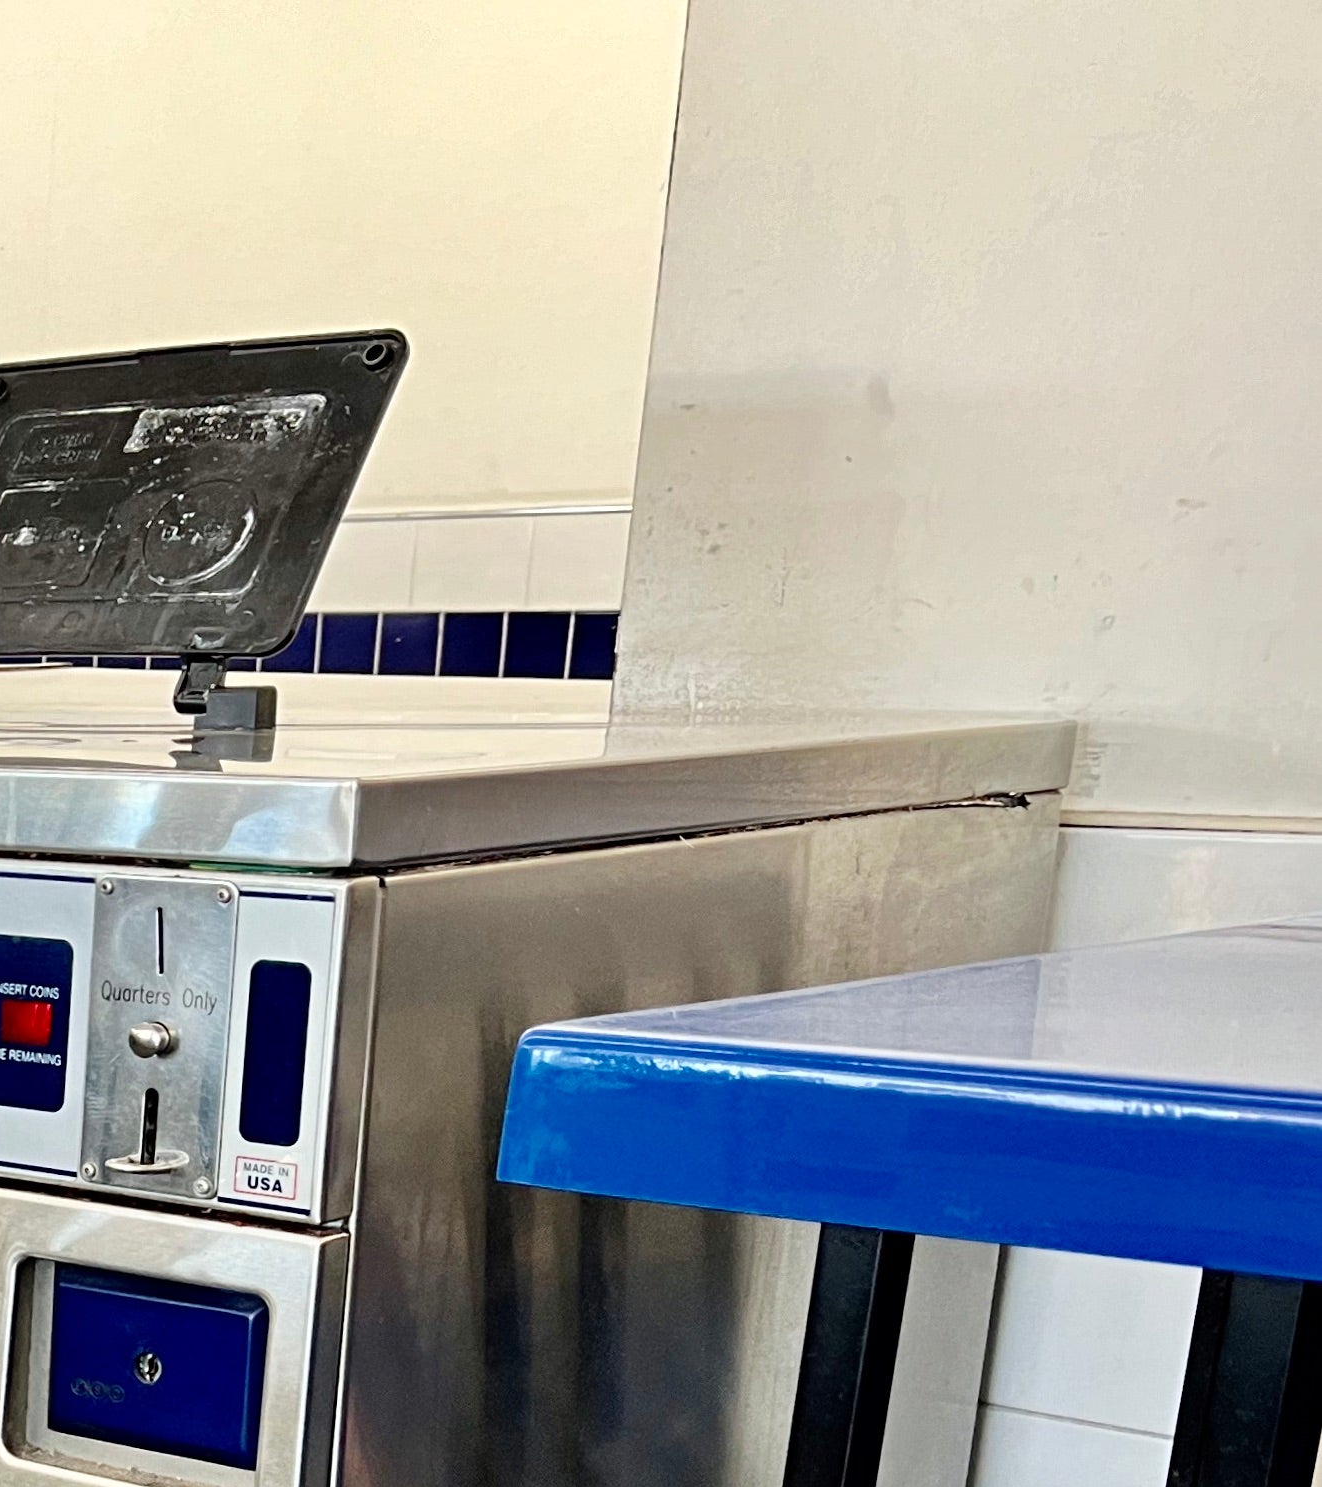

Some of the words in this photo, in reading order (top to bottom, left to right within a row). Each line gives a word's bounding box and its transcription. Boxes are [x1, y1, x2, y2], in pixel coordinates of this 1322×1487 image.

[29, 984, 60, 1000] COINS
[100, 979, 171, 1006] Quarters
[182, 987, 218, 1017] Only
[8, 1049, 62, 1066] REMAINING
[243, 1161, 274, 1175] MADE
[278, 1165, 290, 1177] IN
[247, 1174, 283, 1194] USA
